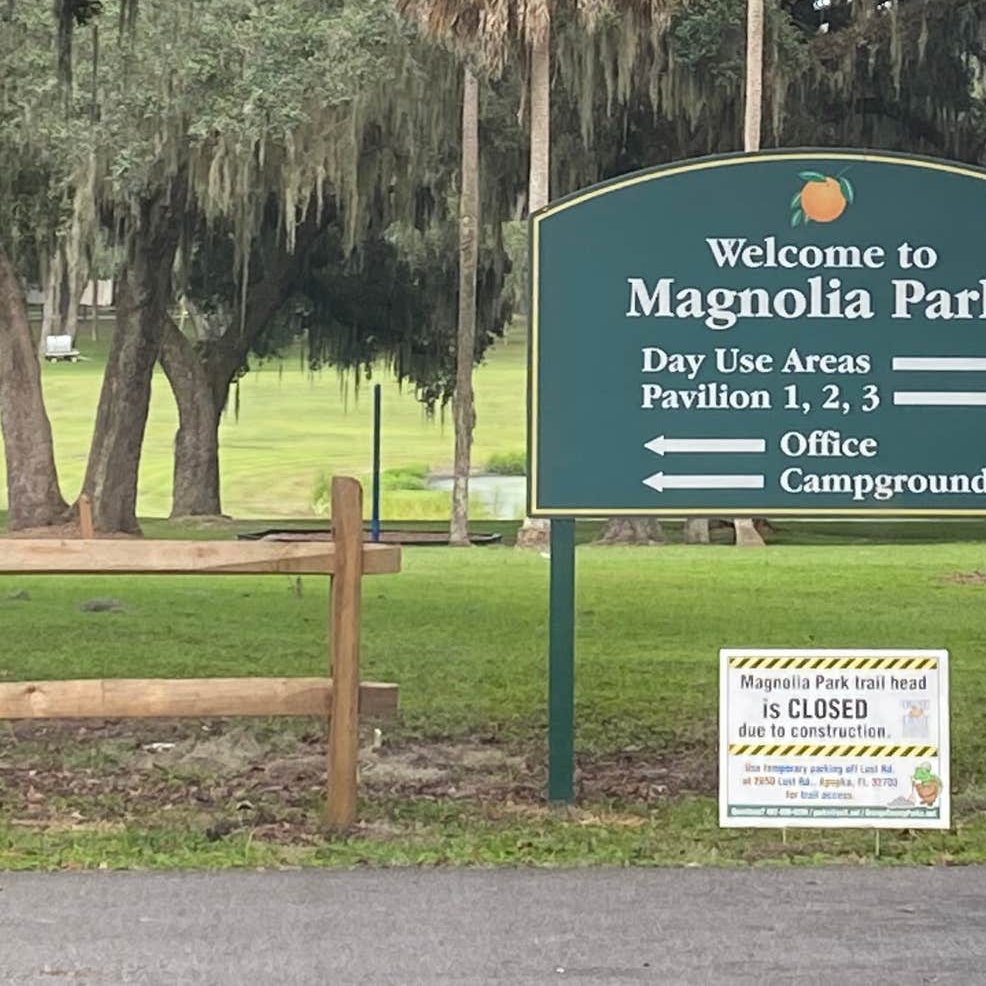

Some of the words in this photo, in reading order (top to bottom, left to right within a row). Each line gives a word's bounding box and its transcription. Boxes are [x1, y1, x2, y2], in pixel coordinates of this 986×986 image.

[706, 237, 884, 268] Welcome
[898, 243, 937, 268] to
[626, 276, 874, 329] Magnolia
[642, 348, 705, 379] Day
[715, 349, 772, 373] Use
[782, 348, 870, 373] Areas
[642, 383, 771, 408] Pavilion
[784, 385, 810, 414] 1,
[823, 385, 849, 414] 2,
[862, 385, 879, 411] 3
[781, 430, 877, 456] Office
[741, 675, 810, 692] Magnolia
[816, 675, 849, 689] Park
[856, 676, 885, 690] trail
[891, 675, 926, 690] head
[763, 699, 780, 719] is
[788, 698, 867, 720] CLOSED
[739, 723, 765, 738] due
[771, 724, 785, 737] to
[791, 724, 890, 738] construction.
[763, 764, 807, 775] temporary
[810, 765, 842, 776] parking
